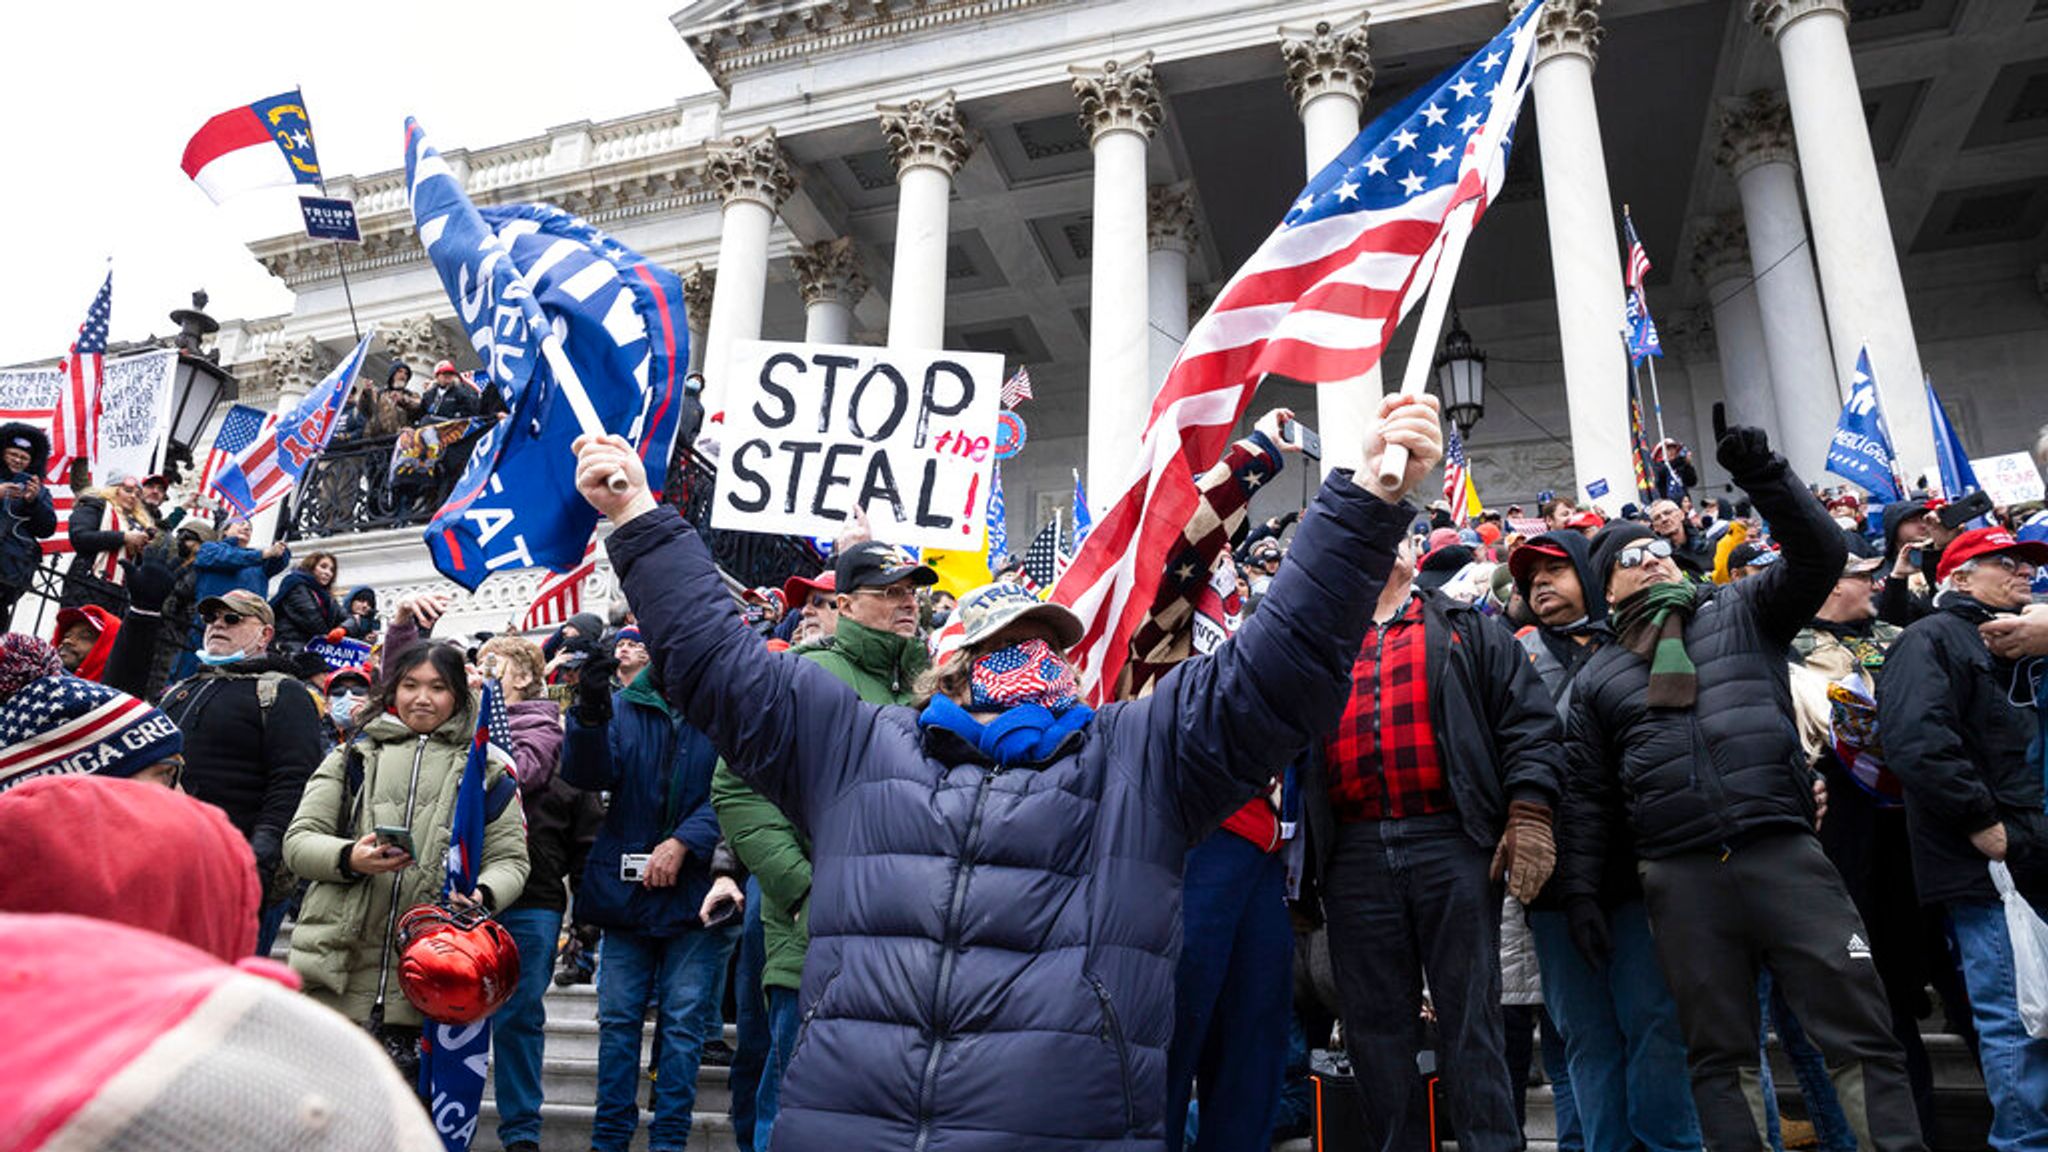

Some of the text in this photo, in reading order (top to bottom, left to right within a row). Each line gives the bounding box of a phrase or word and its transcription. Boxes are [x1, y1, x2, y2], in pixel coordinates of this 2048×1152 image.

[304, 206, 353, 219] TRUMP
[752, 352, 976, 449] STOP
[934, 430, 990, 463] the
[728, 438, 979, 535] STEAL!
